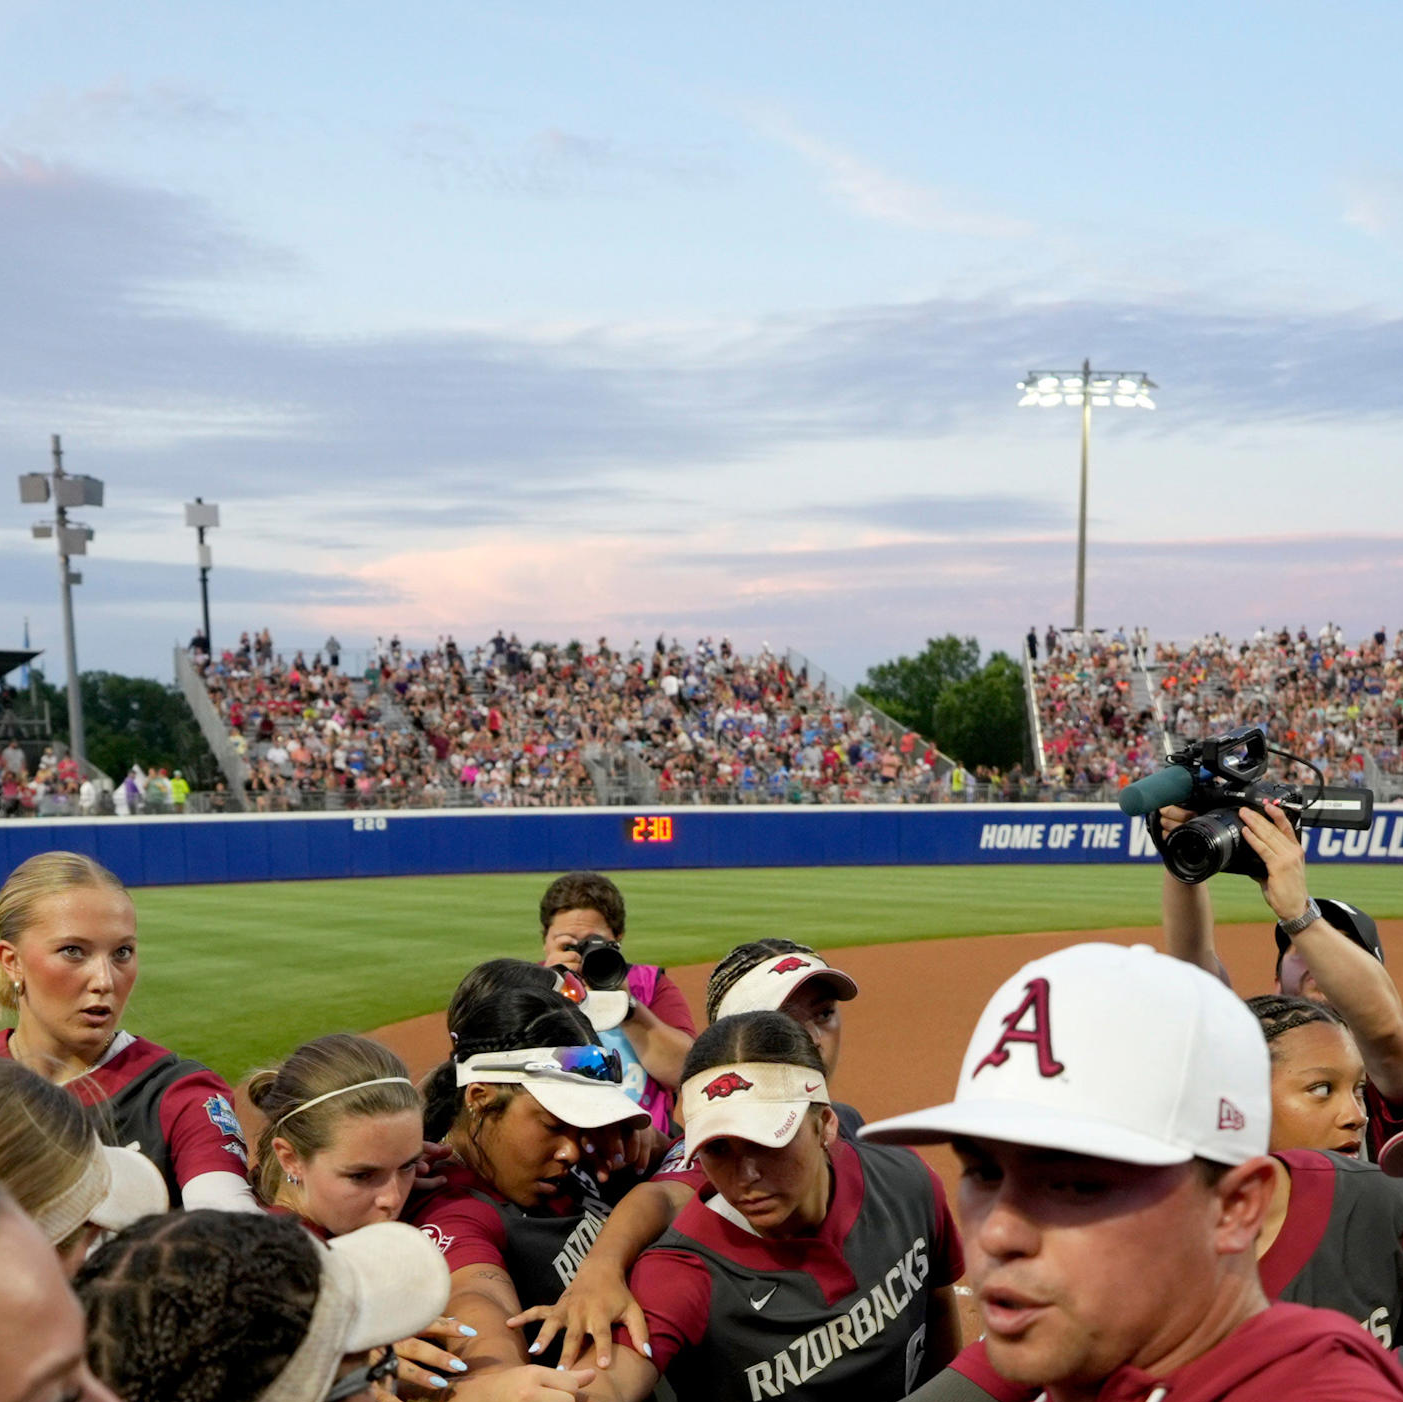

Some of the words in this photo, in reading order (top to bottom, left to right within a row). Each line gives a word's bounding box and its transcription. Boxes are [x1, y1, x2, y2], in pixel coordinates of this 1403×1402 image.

[980, 823, 1046, 849] HOME
[1047, 823, 1078, 849] OF
[1082, 823, 1124, 849] THE
[972, 977, 1065, 1079] A
[773, 1110, 798, 1140] ARKANSAS
[744, 1237, 929, 1402] RAZORBACKS
